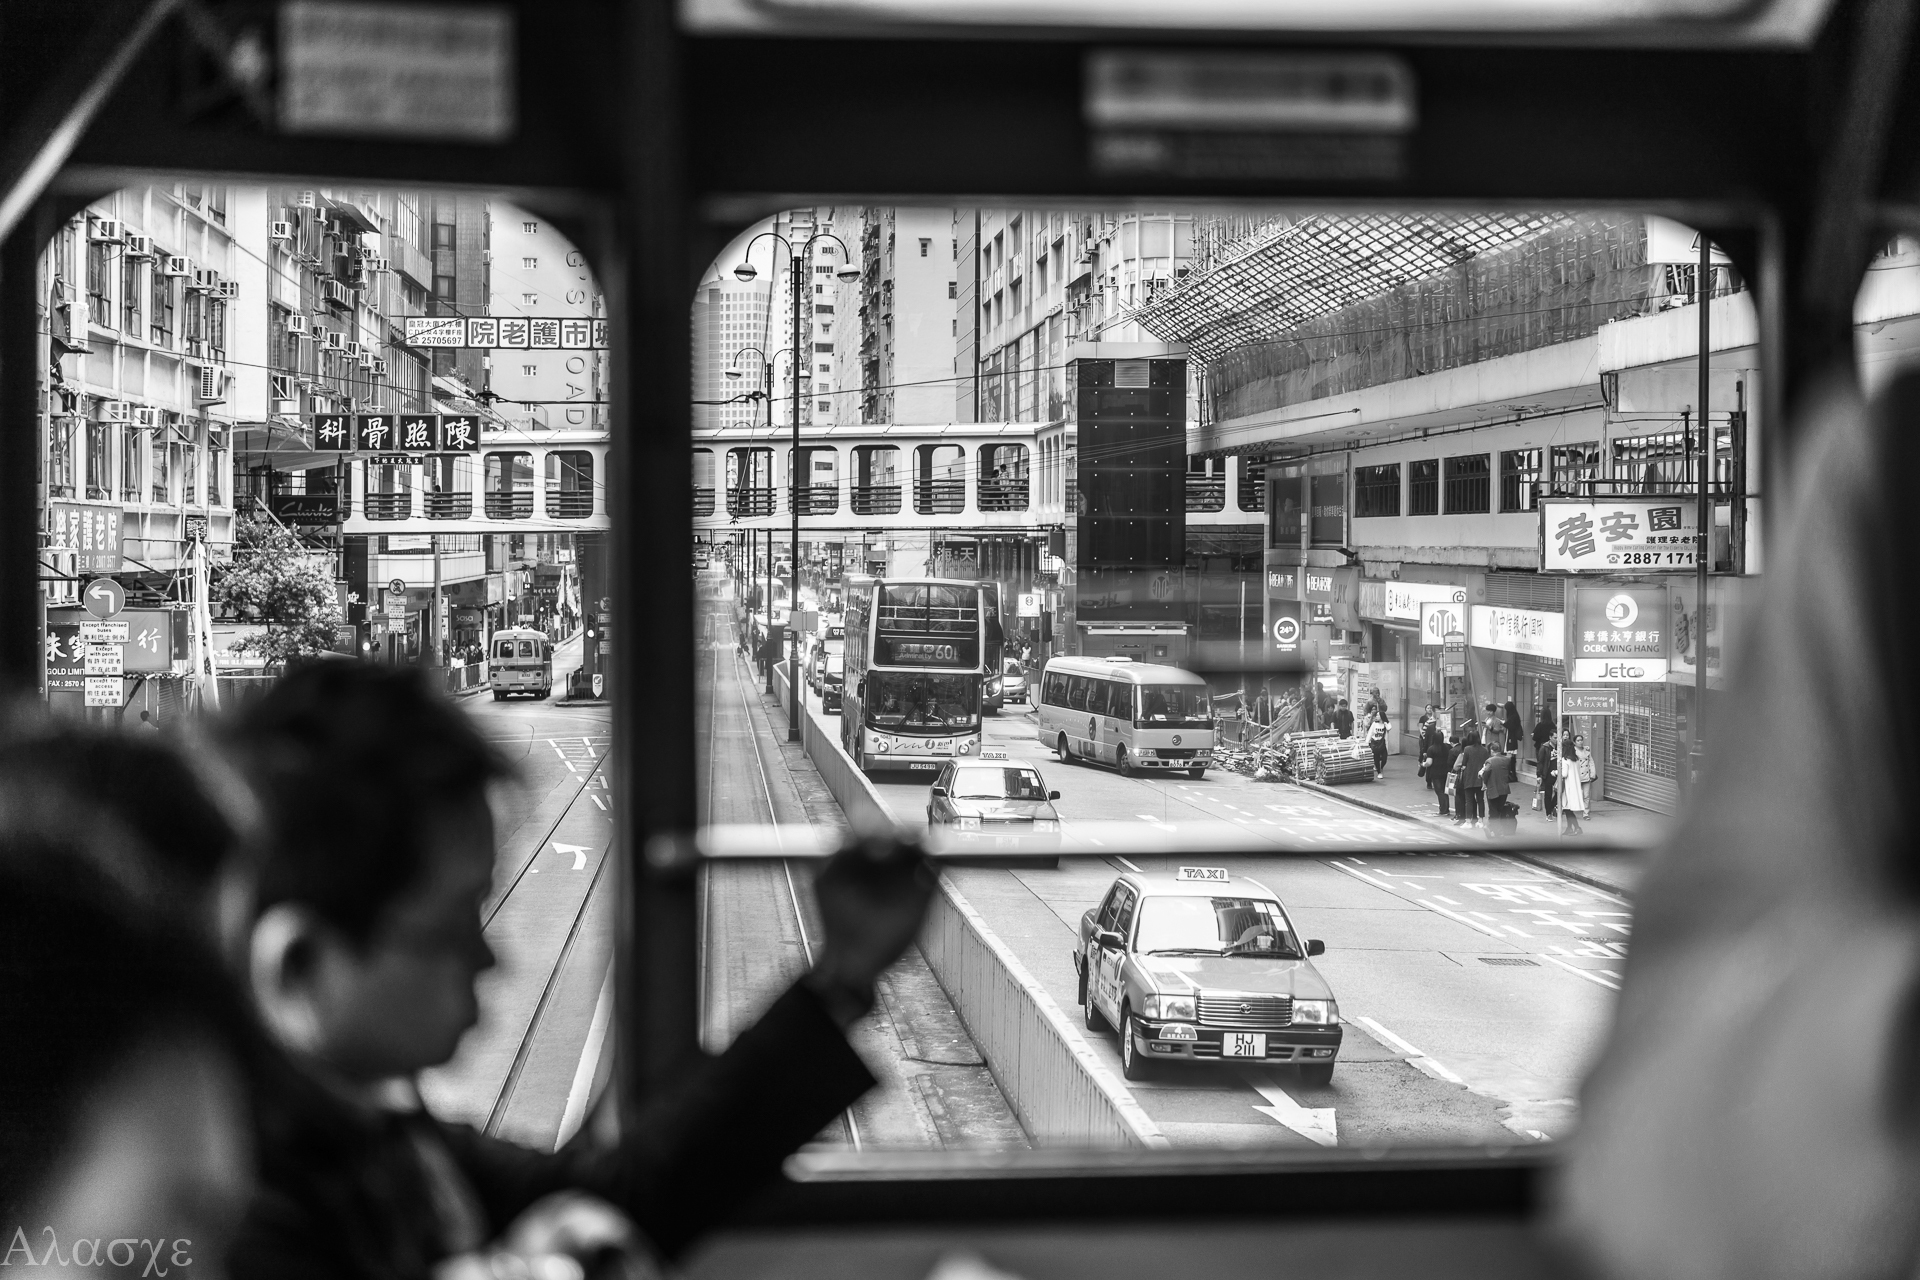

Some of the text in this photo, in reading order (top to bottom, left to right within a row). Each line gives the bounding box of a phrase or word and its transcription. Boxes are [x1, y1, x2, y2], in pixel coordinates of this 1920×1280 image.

[421, 336, 462, 345] 25705697
[565, 356, 588, 425] OAD
[278, 501, 333, 517] Clarks
[1623, 552, 1662, 565] 2887
[935, 643, 958, 660] 601
[1607, 644, 1632, 653] WING
[1634, 644, 1660, 653] HANG
[898, 652, 933, 661] Admiralty
[1184, 868, 1225, 879] TAXI
[1174, 1026, 1182, 1034] 4
[1235, 1033, 1254, 1045] HJ
[1234, 1044, 1255, 1056] 2111
